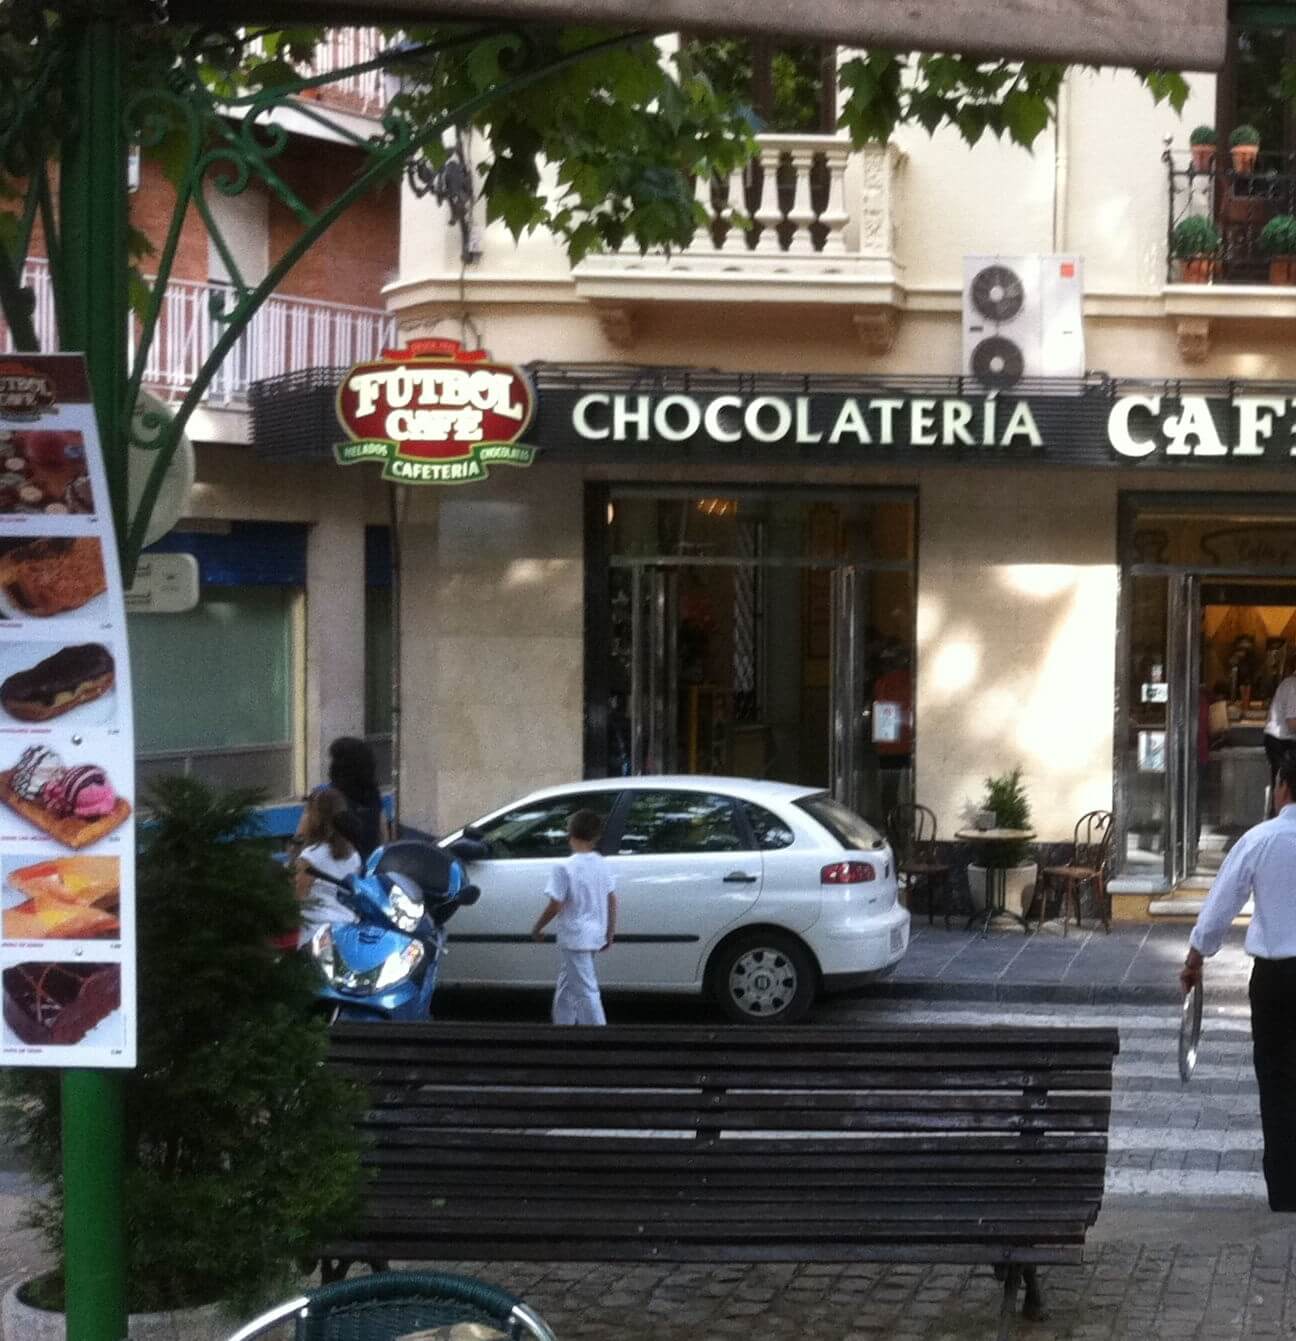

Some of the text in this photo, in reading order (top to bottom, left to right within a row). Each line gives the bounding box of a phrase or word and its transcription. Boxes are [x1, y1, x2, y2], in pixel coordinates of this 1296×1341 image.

[350, 366, 523, 421] FÚTBOL
[385, 406, 483, 441] CAFÉ
[572, 391, 1044, 447] CHOCOLATERÍA
[392, 461, 480, 479] CAFETERÍA
